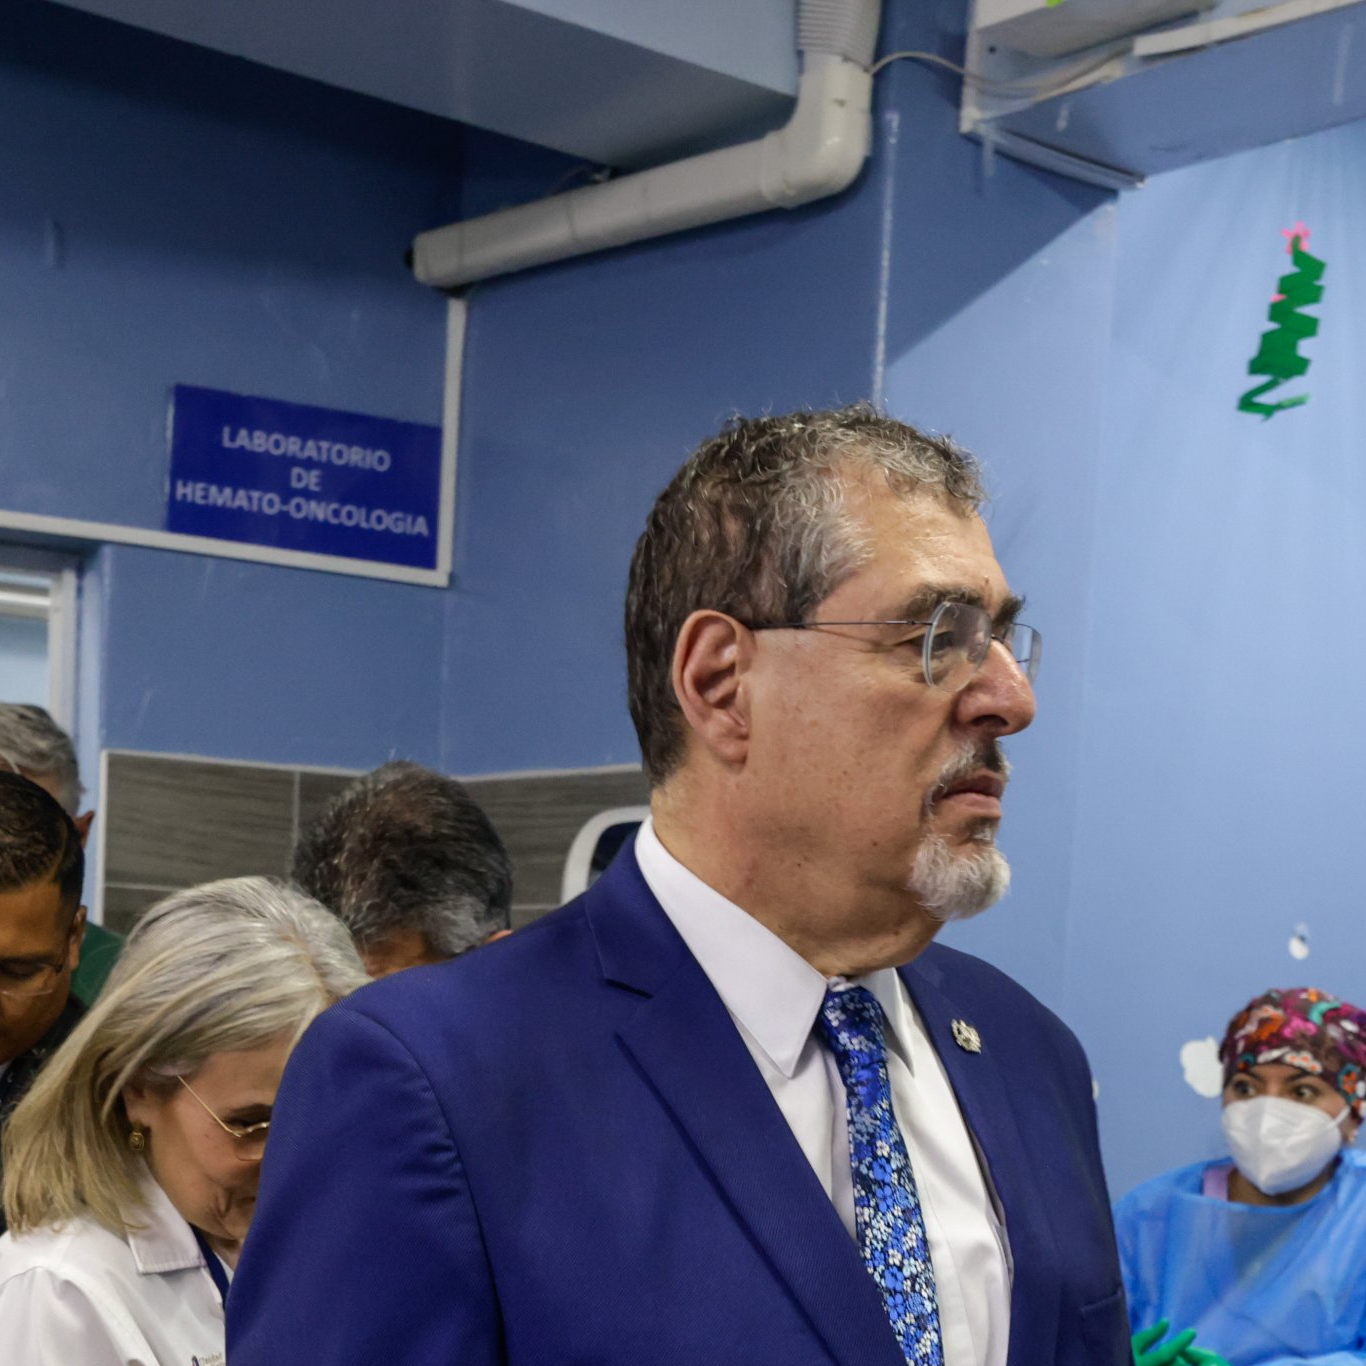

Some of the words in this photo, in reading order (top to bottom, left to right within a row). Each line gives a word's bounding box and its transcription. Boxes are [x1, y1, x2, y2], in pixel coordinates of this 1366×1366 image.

[222, 426, 392, 472] LABORATORIO
[290, 466, 323, 492] DE
[175, 479, 430, 538] HEMATO-ONCOLOGIA
